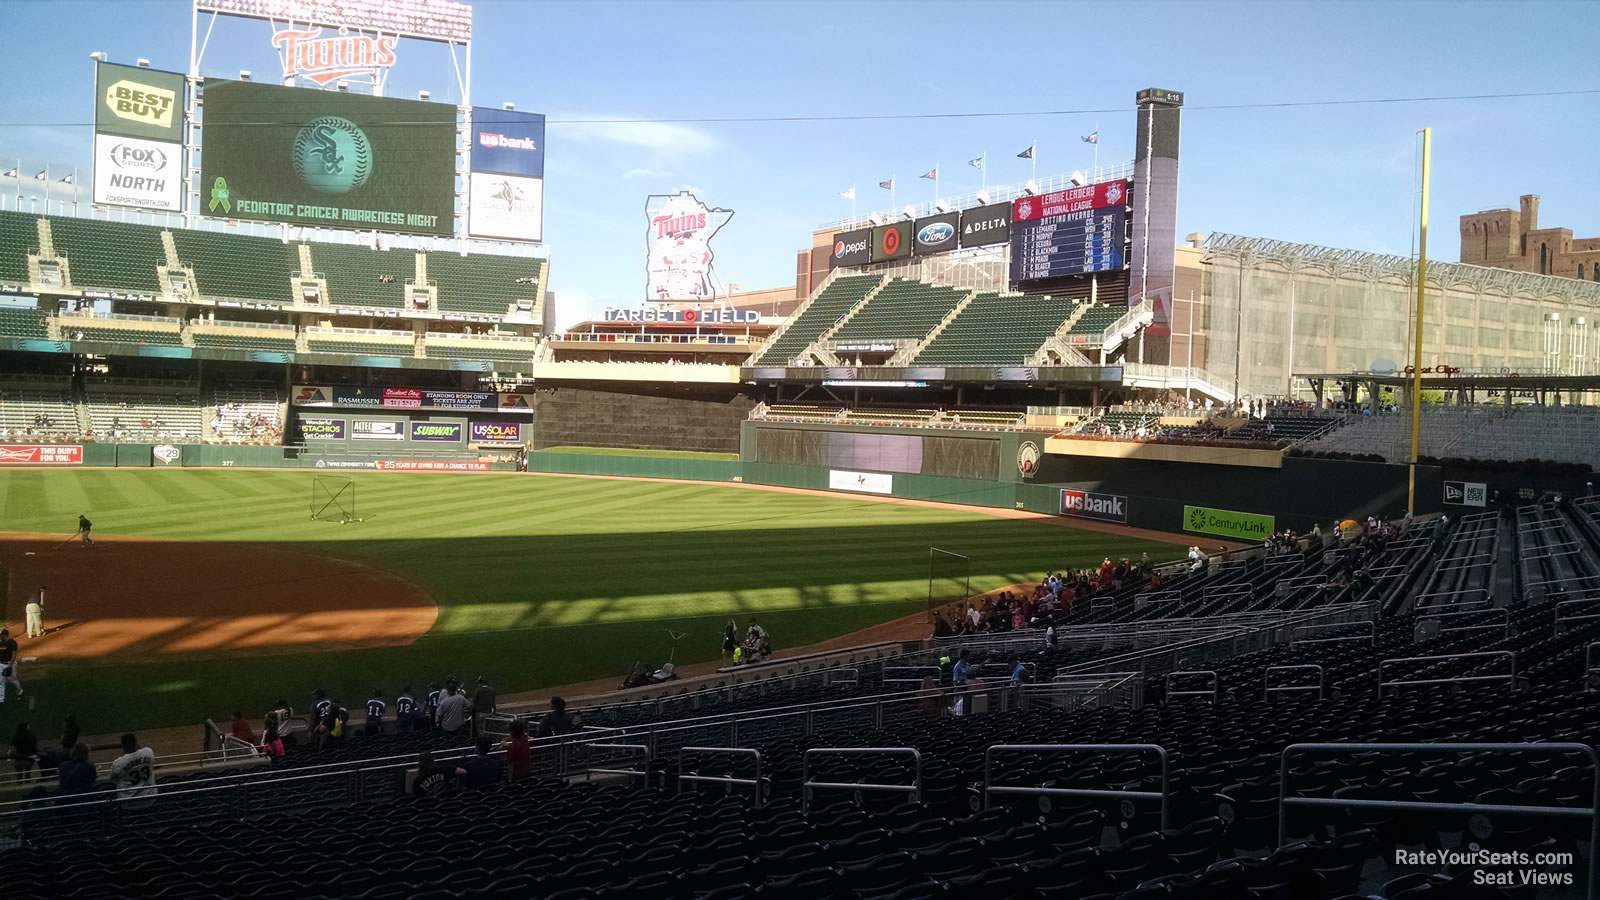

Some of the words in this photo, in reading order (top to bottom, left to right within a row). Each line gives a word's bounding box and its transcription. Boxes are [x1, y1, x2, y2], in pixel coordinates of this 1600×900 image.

[272, 26, 396, 76] Twins
[116, 86, 172, 109] BEST
[117, 100, 167, 120] BUY
[122, 146, 155, 163] FOX
[310, 126, 345, 175] Sox
[122, 160, 156, 169] SPORTS
[110, 174, 165, 192] NORTH
[106, 195, 170, 207] FOXSPORTSNORTH.COM
[1042, 192, 1065, 205] LEAGUE
[1066, 186, 1095, 200] LEADERS
[236, 200, 294, 216] PEDIATRIC
[296, 205, 340, 220] CANCER
[342, 208, 404, 224] AWARENESS
[407, 214, 438, 227] NIGHT
[1042, 204, 1070, 216] NATIONAL
[1070, 200, 1092, 212] LEAGUE
[653, 211, 706, 240] Twins
[974, 218, 1006, 232] DELTA
[1040, 214, 1066, 226] BATTING
[1067, 210, 1094, 222] AVERAGE
[924, 226, 946, 242] Ford
[1036, 232, 1053, 240] MURPHY
[845, 240, 866, 256] pepsi
[1036, 240, 1052, 248] SEGURA
[1036, 246, 1058, 255] BLACKMON
[605, 310, 680, 322] TARGET
[701, 310, 761, 323] FIELD
[1436, 365, 1460, 378] Clips
[354, 422, 372, 430] ALTEC
[413, 426, 459, 436] SUBWAY
[1209, 516, 1266, 534] CenturyLink
[280, 712, 289, 720] 19
[368, 706, 380, 716] 11
[399, 703, 410, 713] 12
[129, 766, 150, 785] 33
[420, 774, 444, 788] BUXTON
